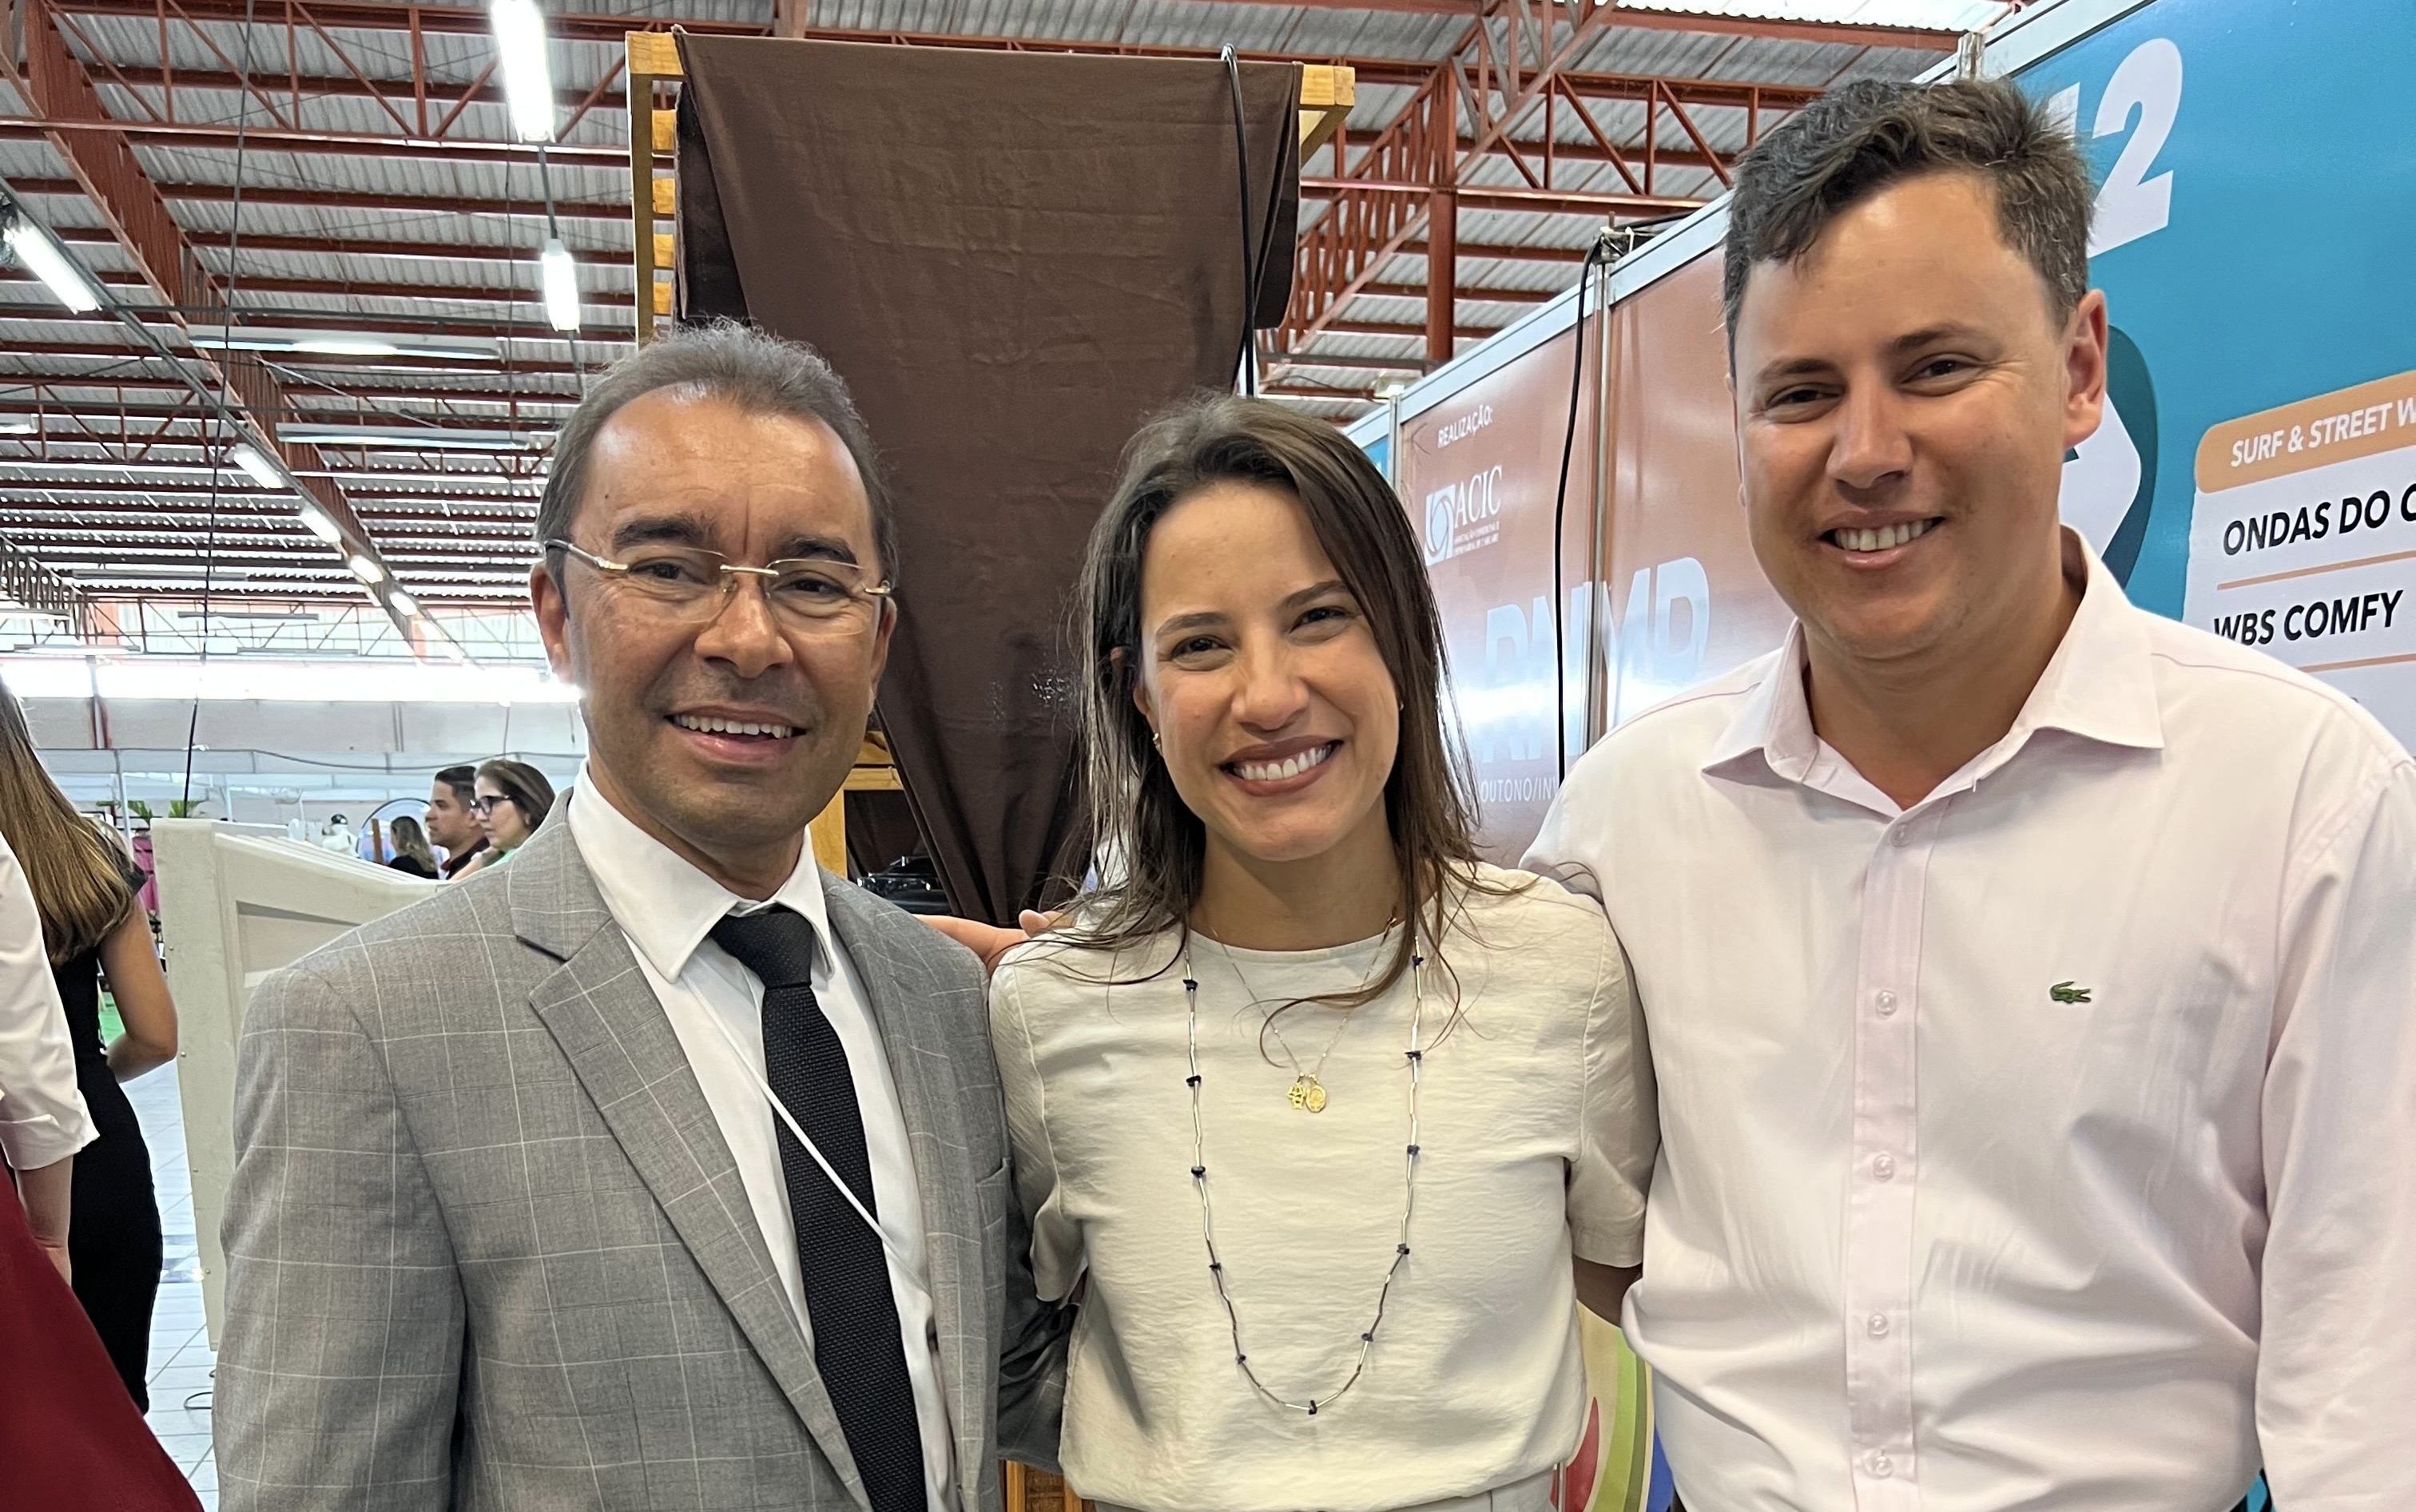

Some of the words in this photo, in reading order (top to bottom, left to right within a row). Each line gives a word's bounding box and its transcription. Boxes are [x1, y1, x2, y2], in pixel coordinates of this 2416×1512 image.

[1437, 404, 1492, 448] REALIZAÇÃO:
[2231, 429, 2284, 467] SURF
[2287, 425, 2303, 453] &
[2308, 402, 2393, 448] STREET
[1454, 464, 1502, 528] ACIC
[2223, 502, 2331, 556] ONDAS
[2339, 490, 2390, 534] DO
[2214, 609, 2276, 646] WBS
[2284, 589, 2403, 641] COMFY
